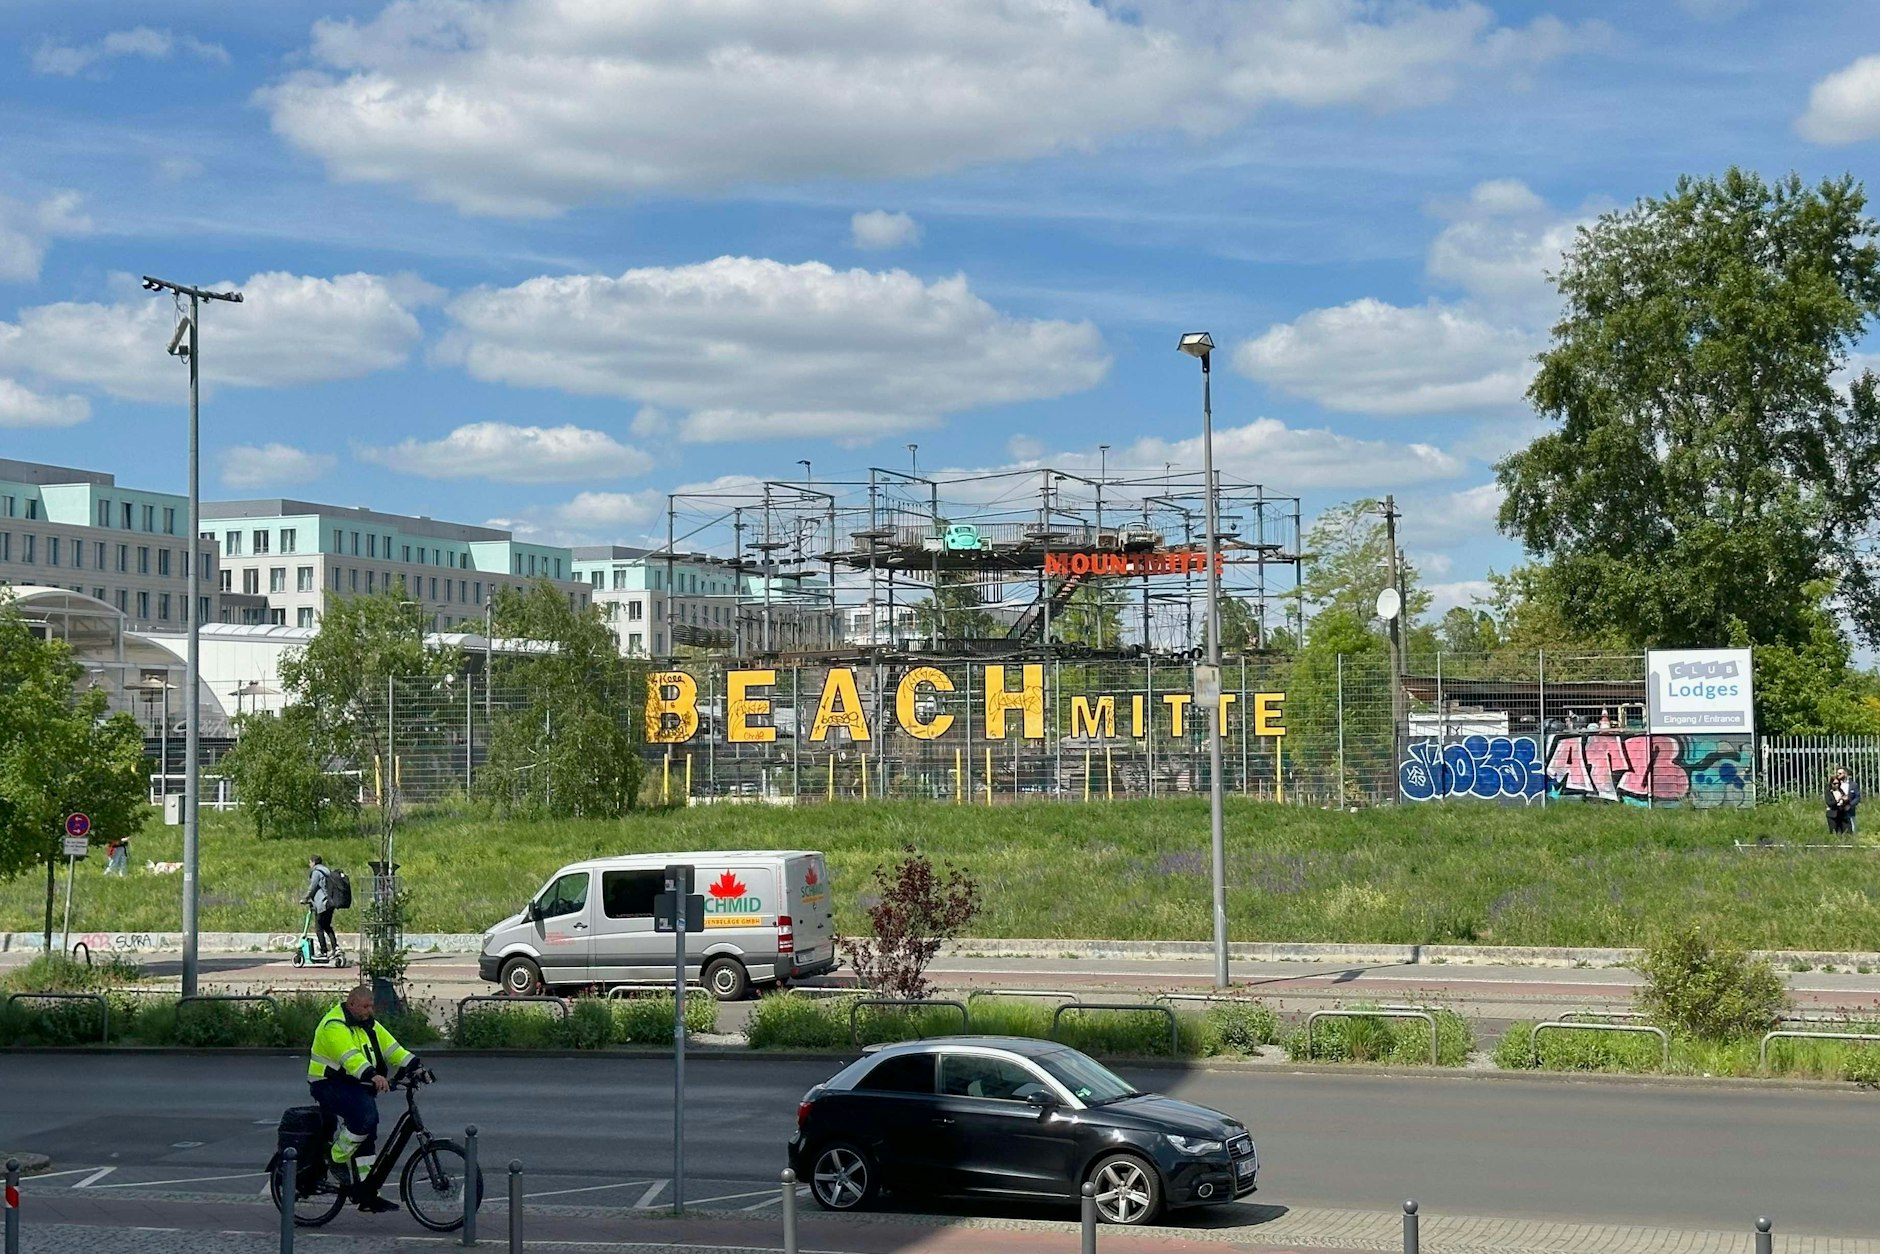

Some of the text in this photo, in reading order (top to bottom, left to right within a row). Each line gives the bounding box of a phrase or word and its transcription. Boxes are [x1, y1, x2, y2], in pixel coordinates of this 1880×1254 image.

[1674, 665, 1733, 675] CLUB
[1668, 681, 1739, 700] Lodges
[645, 663, 1045, 744] BEACH
[1663, 715, 1697, 724] Eingang
[1703, 714, 1741, 723] Entrance
[703, 897, 762, 913] CHMID
[115, 934, 151, 949] SUPRA
